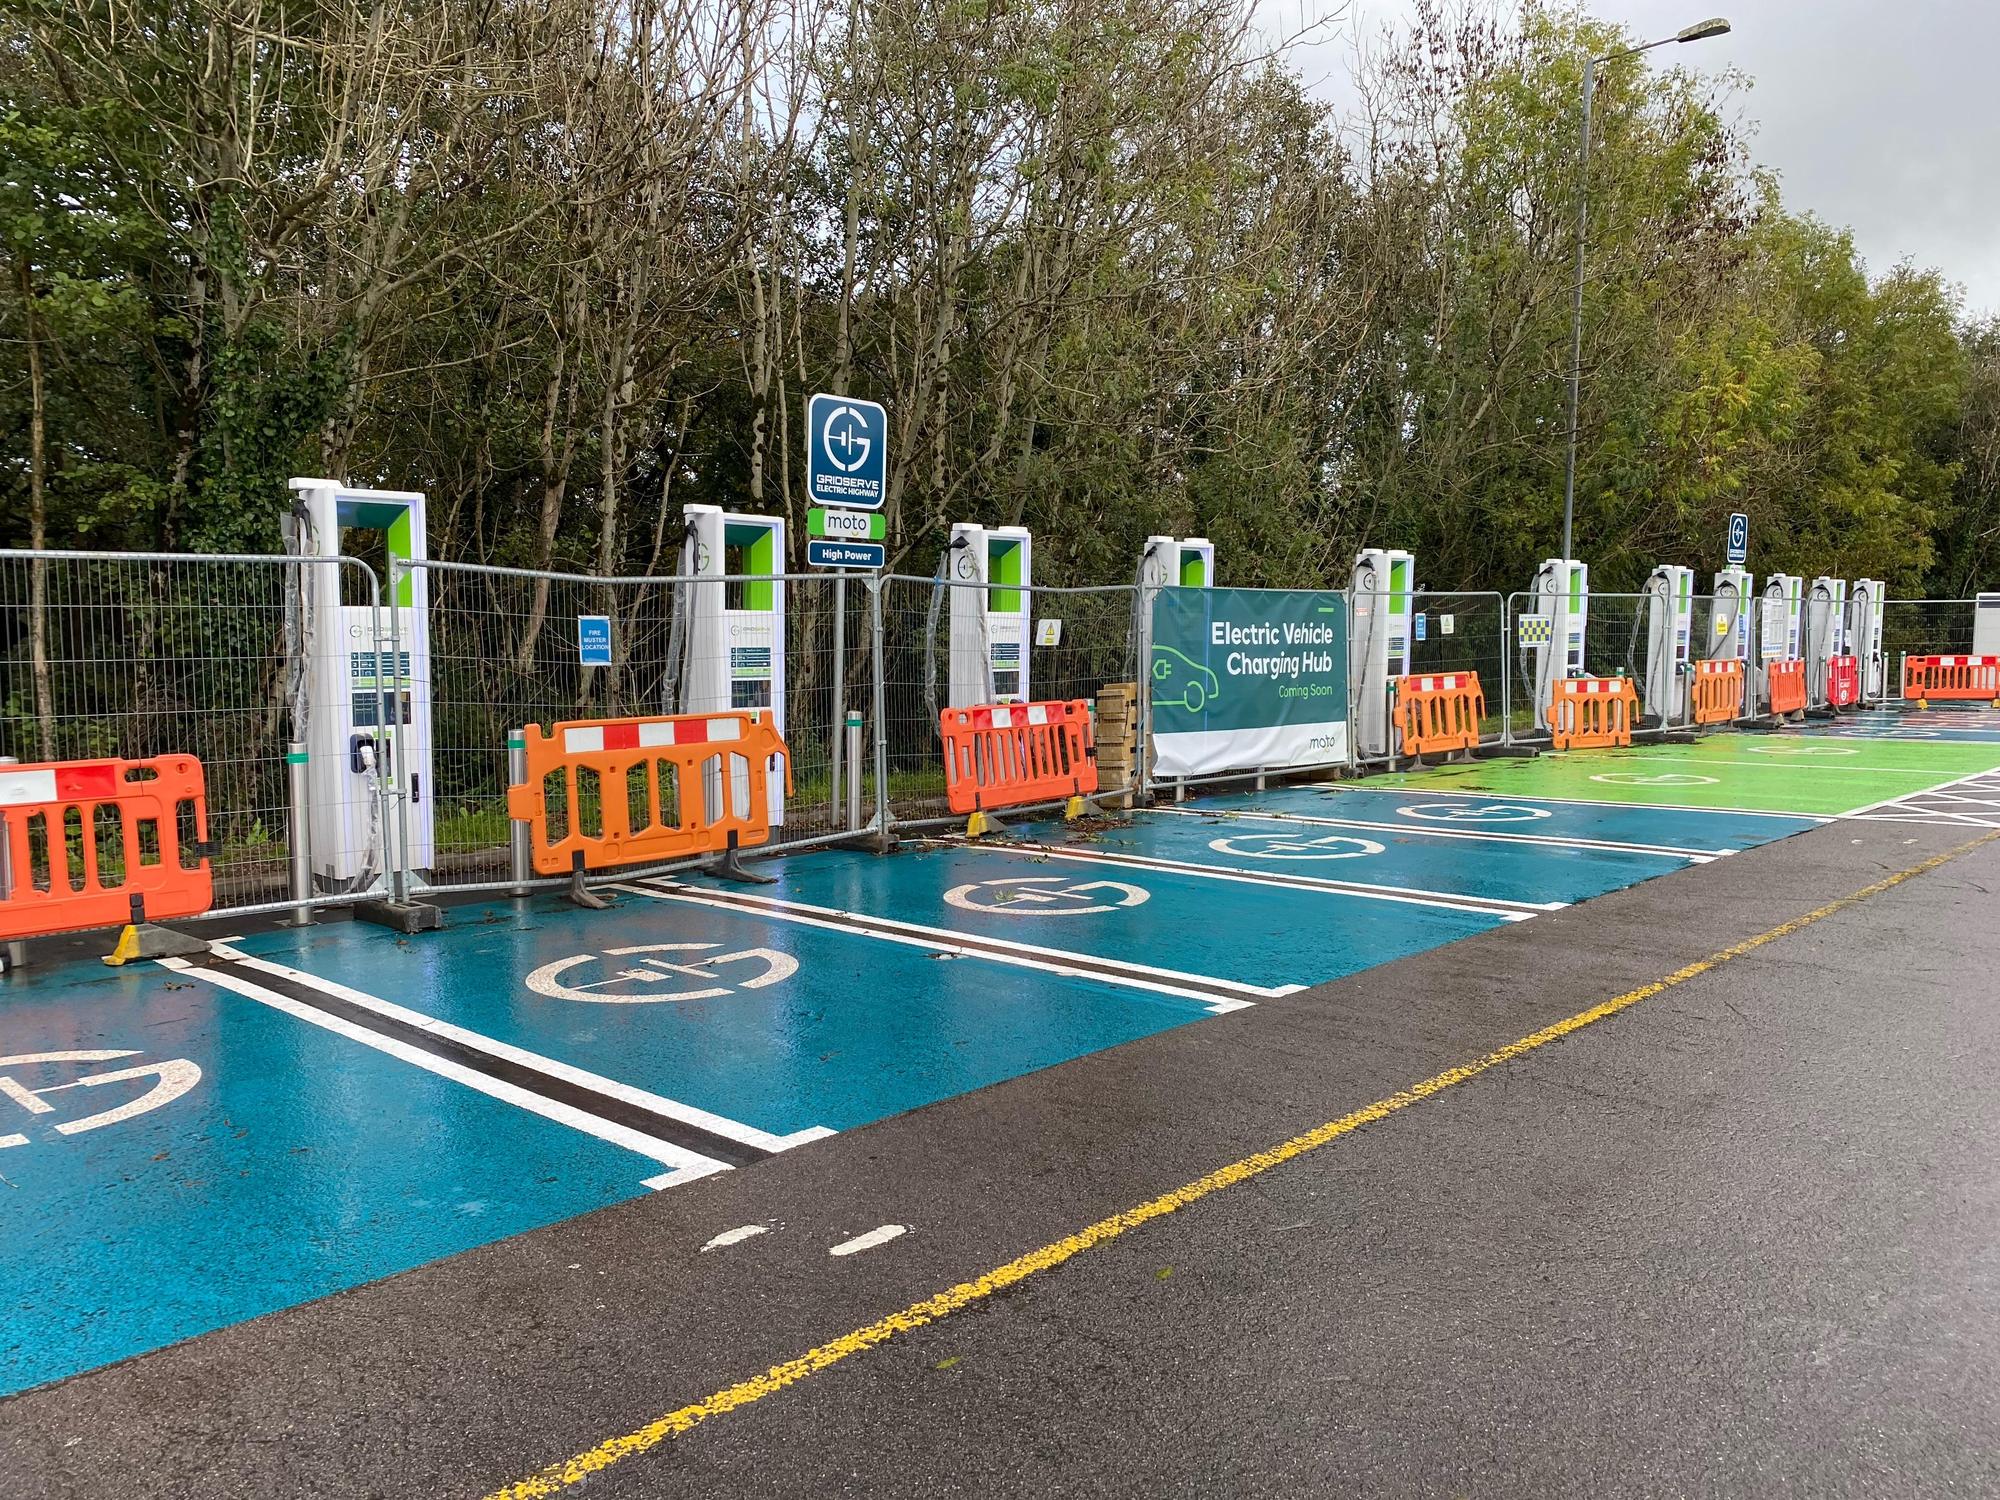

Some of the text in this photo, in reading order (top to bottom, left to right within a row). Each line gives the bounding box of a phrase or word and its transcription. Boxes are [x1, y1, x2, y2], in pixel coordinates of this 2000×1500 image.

[816, 474, 880, 490] GRIDSERVE
[816, 484, 879, 498] ELECTRIC HIGHWAY
[828, 515, 867, 530] moto
[822, 549, 872, 561] High Power
[1212, 621, 1333, 645] Electric Vehicle
[1226, 651, 1333, 679] Charging Hub
[1278, 683, 1333, 700] Coming Soon
[1310, 734, 1335, 749] moto
